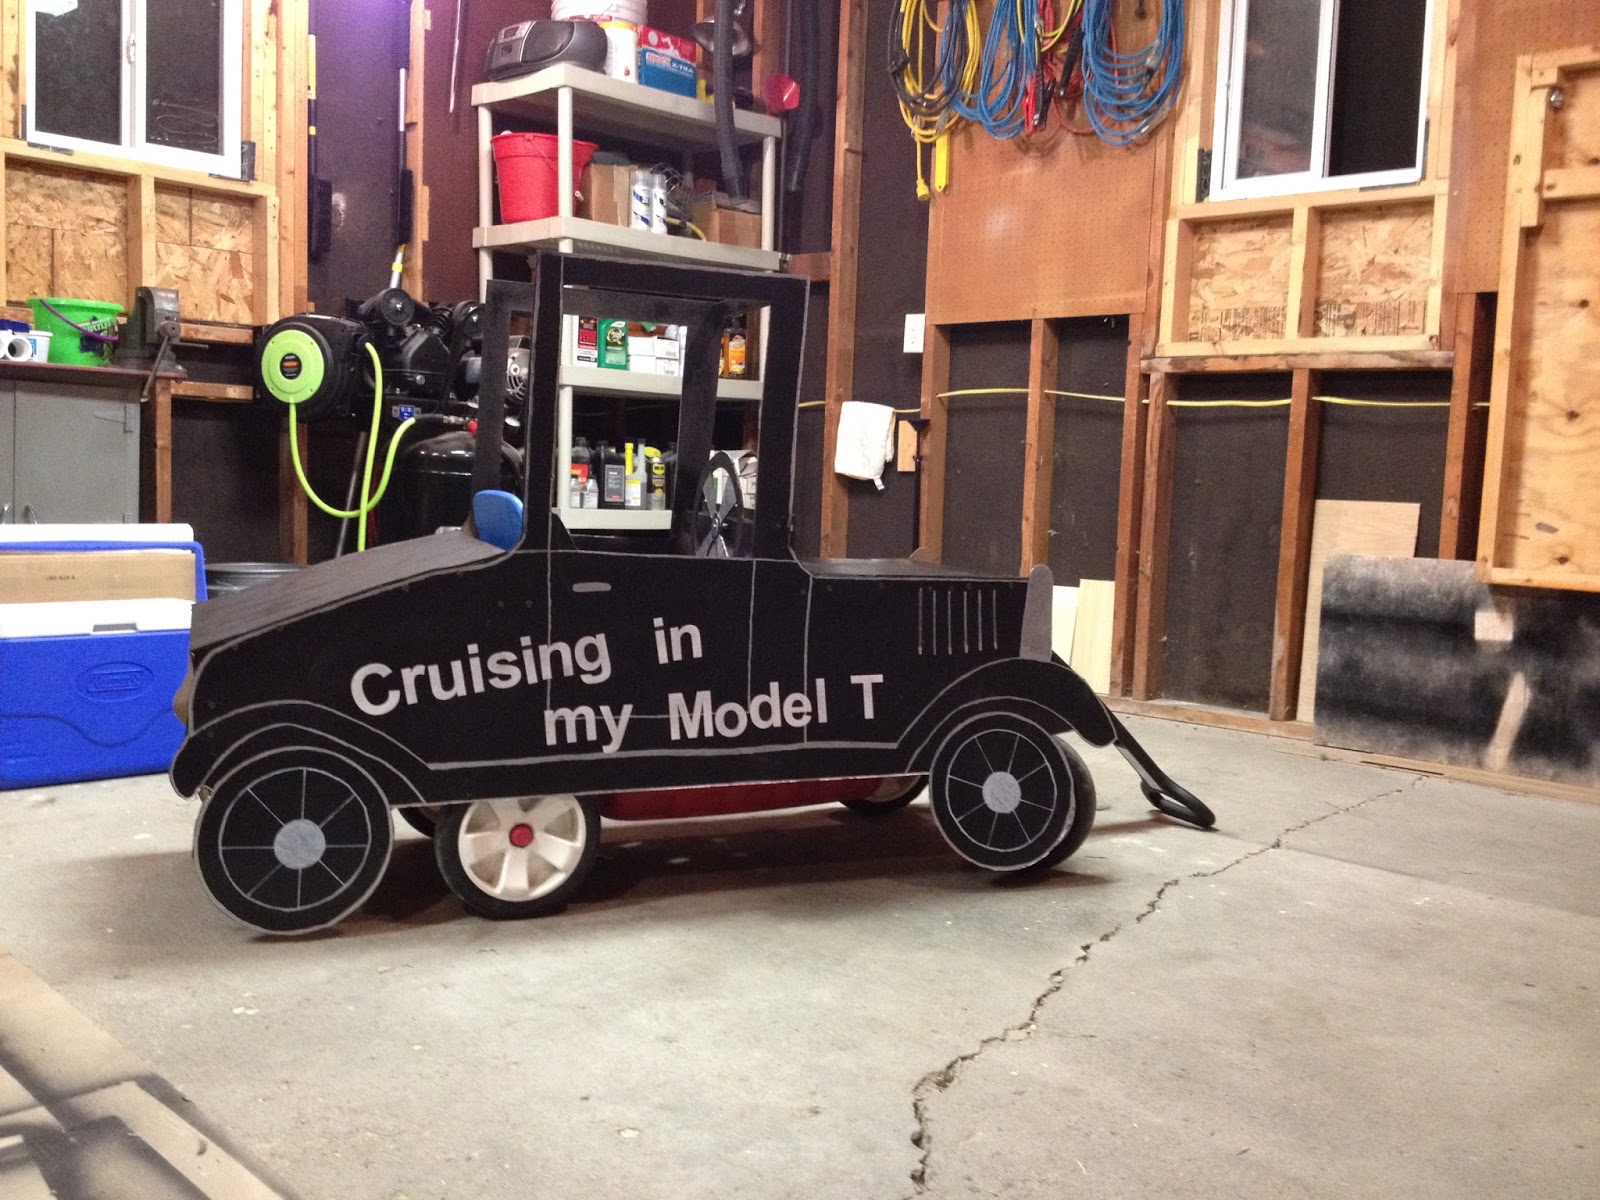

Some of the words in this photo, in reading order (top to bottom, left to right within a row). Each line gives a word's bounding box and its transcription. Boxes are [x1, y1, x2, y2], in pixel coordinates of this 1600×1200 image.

[350, 633, 612, 716] Cruising
[653, 617, 704, 665] in
[543, 703, 633, 755] my
[668, 677, 828, 741] Model
[850, 674, 884, 720] T
